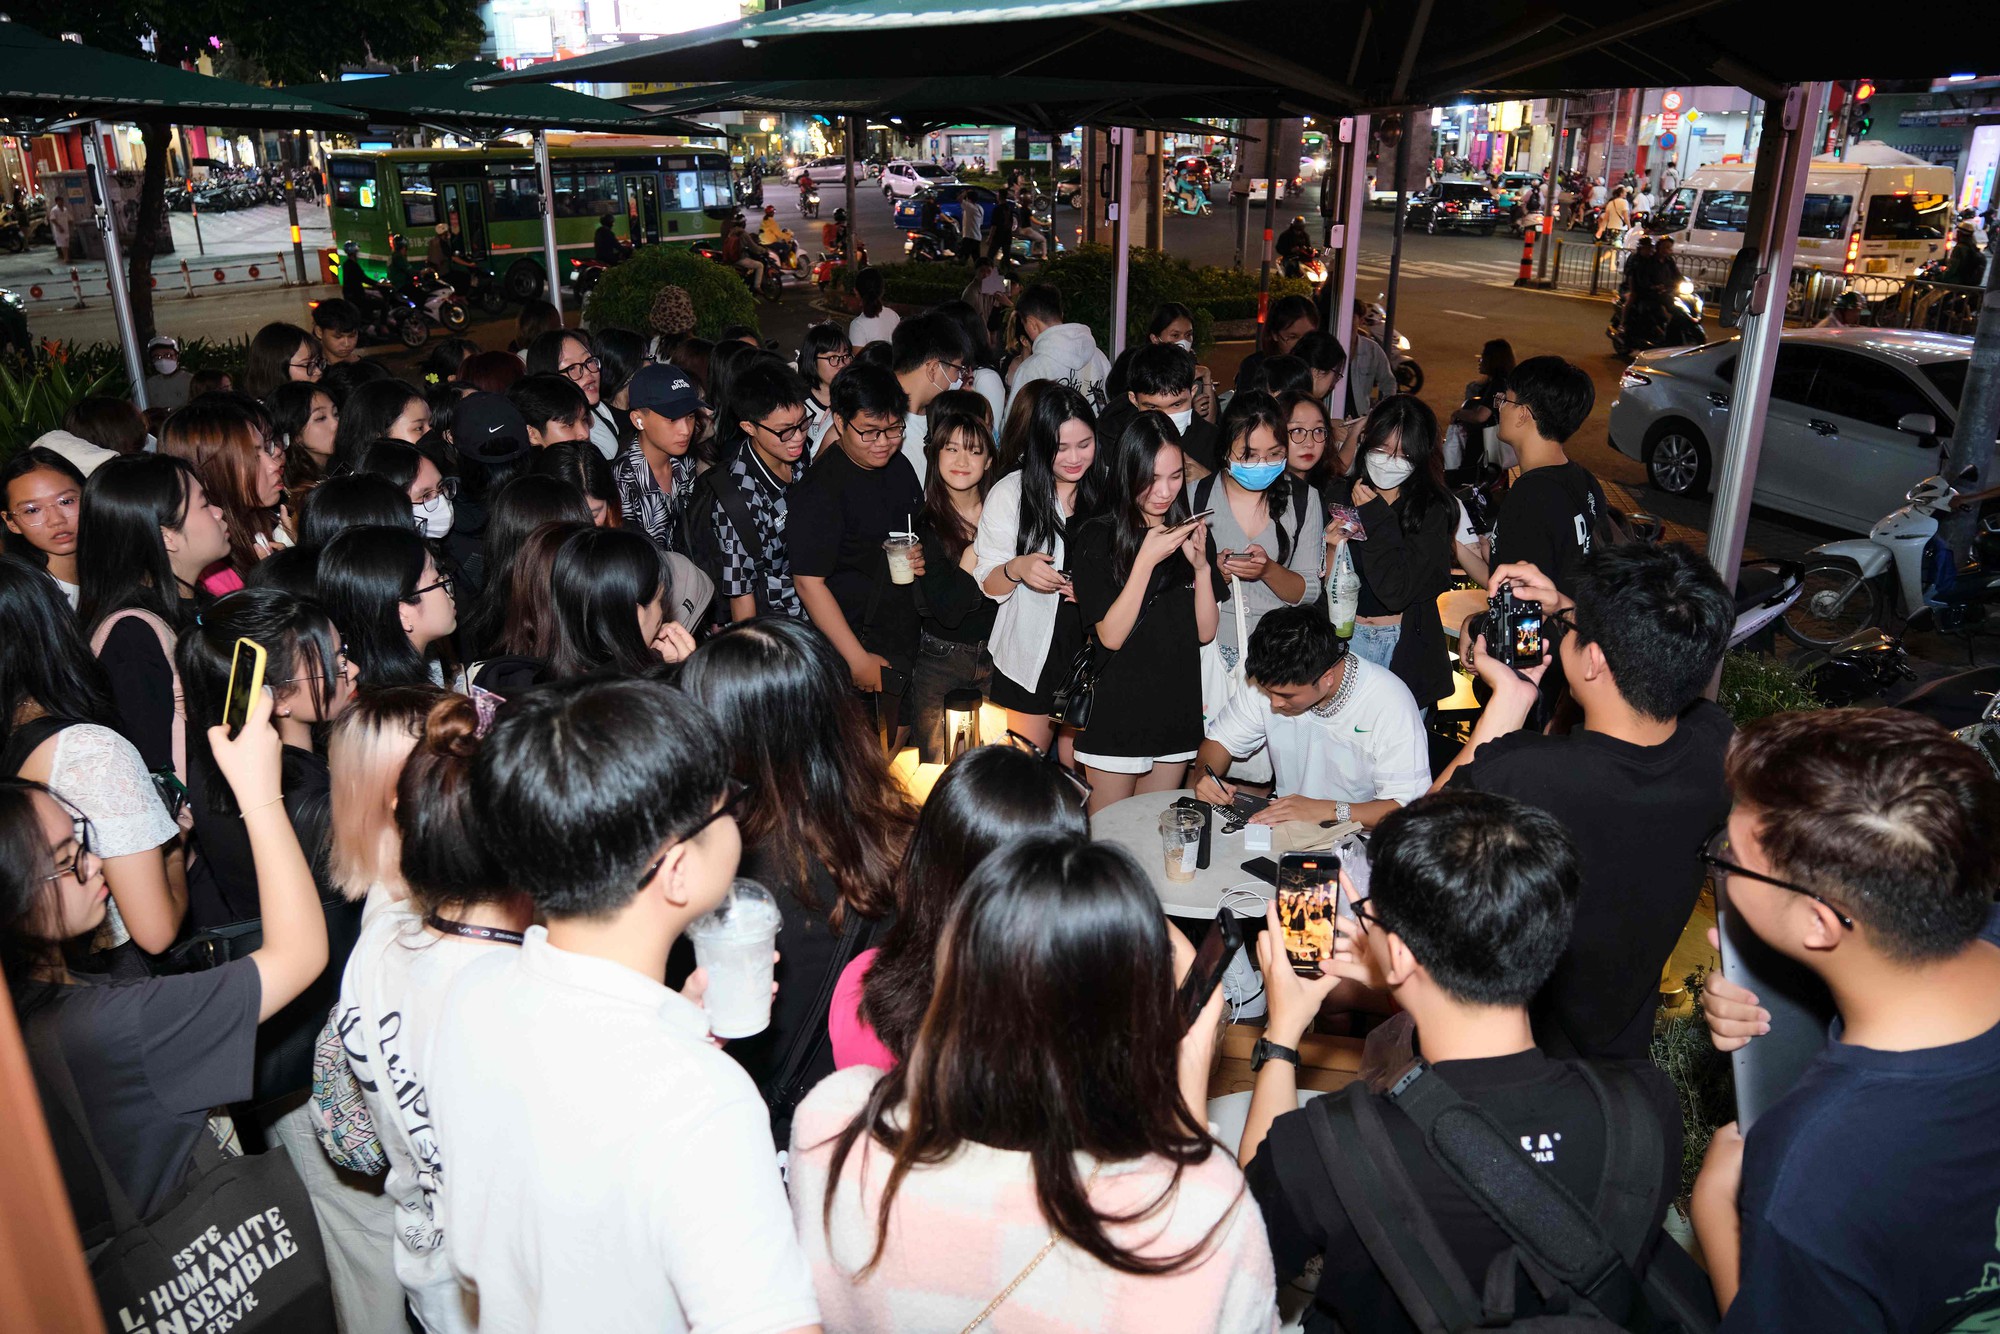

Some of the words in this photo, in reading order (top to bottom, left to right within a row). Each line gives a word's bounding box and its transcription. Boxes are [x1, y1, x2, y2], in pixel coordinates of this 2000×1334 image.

[118, 1206, 286, 1333] L'HUMANITE
[131, 1228, 299, 1334] NSEMBLE
[171, 1224, 222, 1271] ESTE
